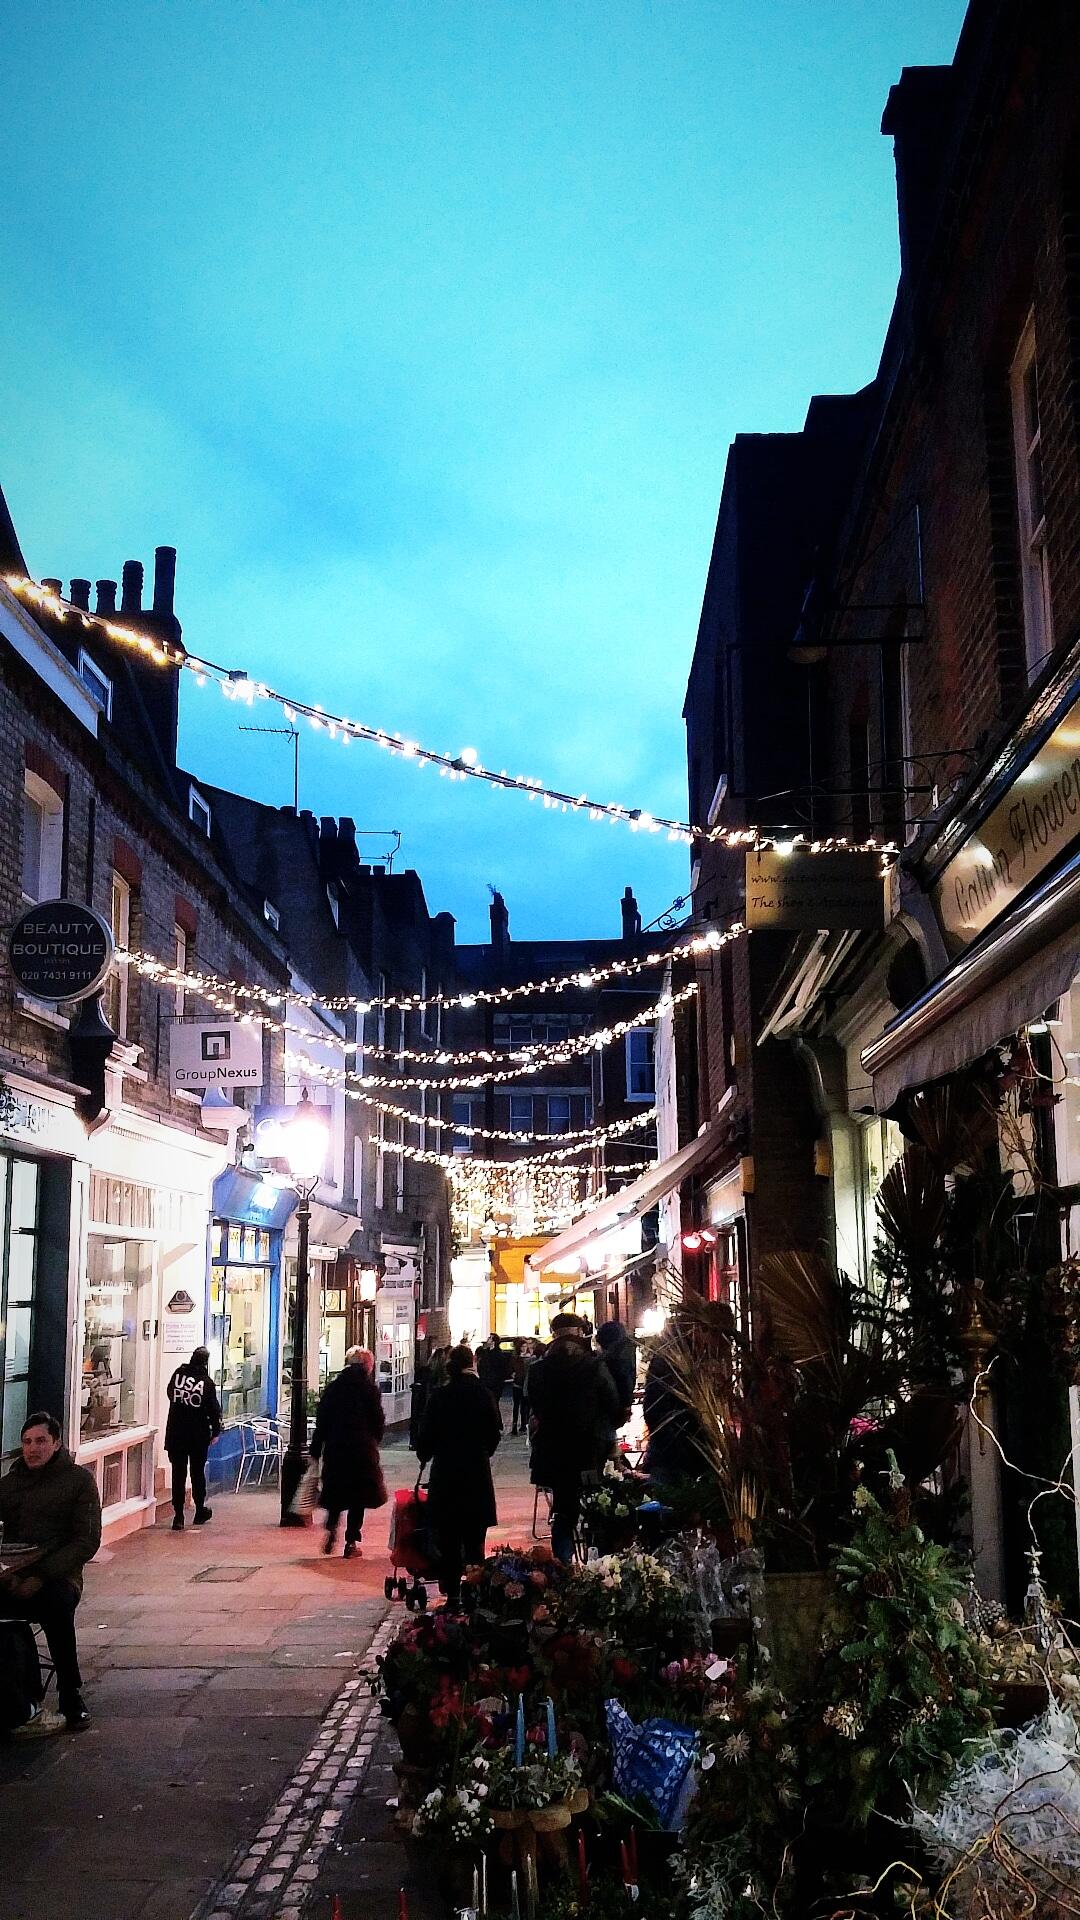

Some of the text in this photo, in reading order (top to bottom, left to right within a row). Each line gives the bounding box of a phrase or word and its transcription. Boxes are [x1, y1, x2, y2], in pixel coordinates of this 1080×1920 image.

[751, 895, 775, 909] The
[23, 923, 94, 934] BEAUTY
[13, 943, 104, 956] BOUTIQUE
[21, 970, 92, 981] 020 7431 9111
[175, 1067, 258, 1082] GroupNexus
[174, 1373, 205, 1396] USA
[173, 1388, 202, 1408] PRO
